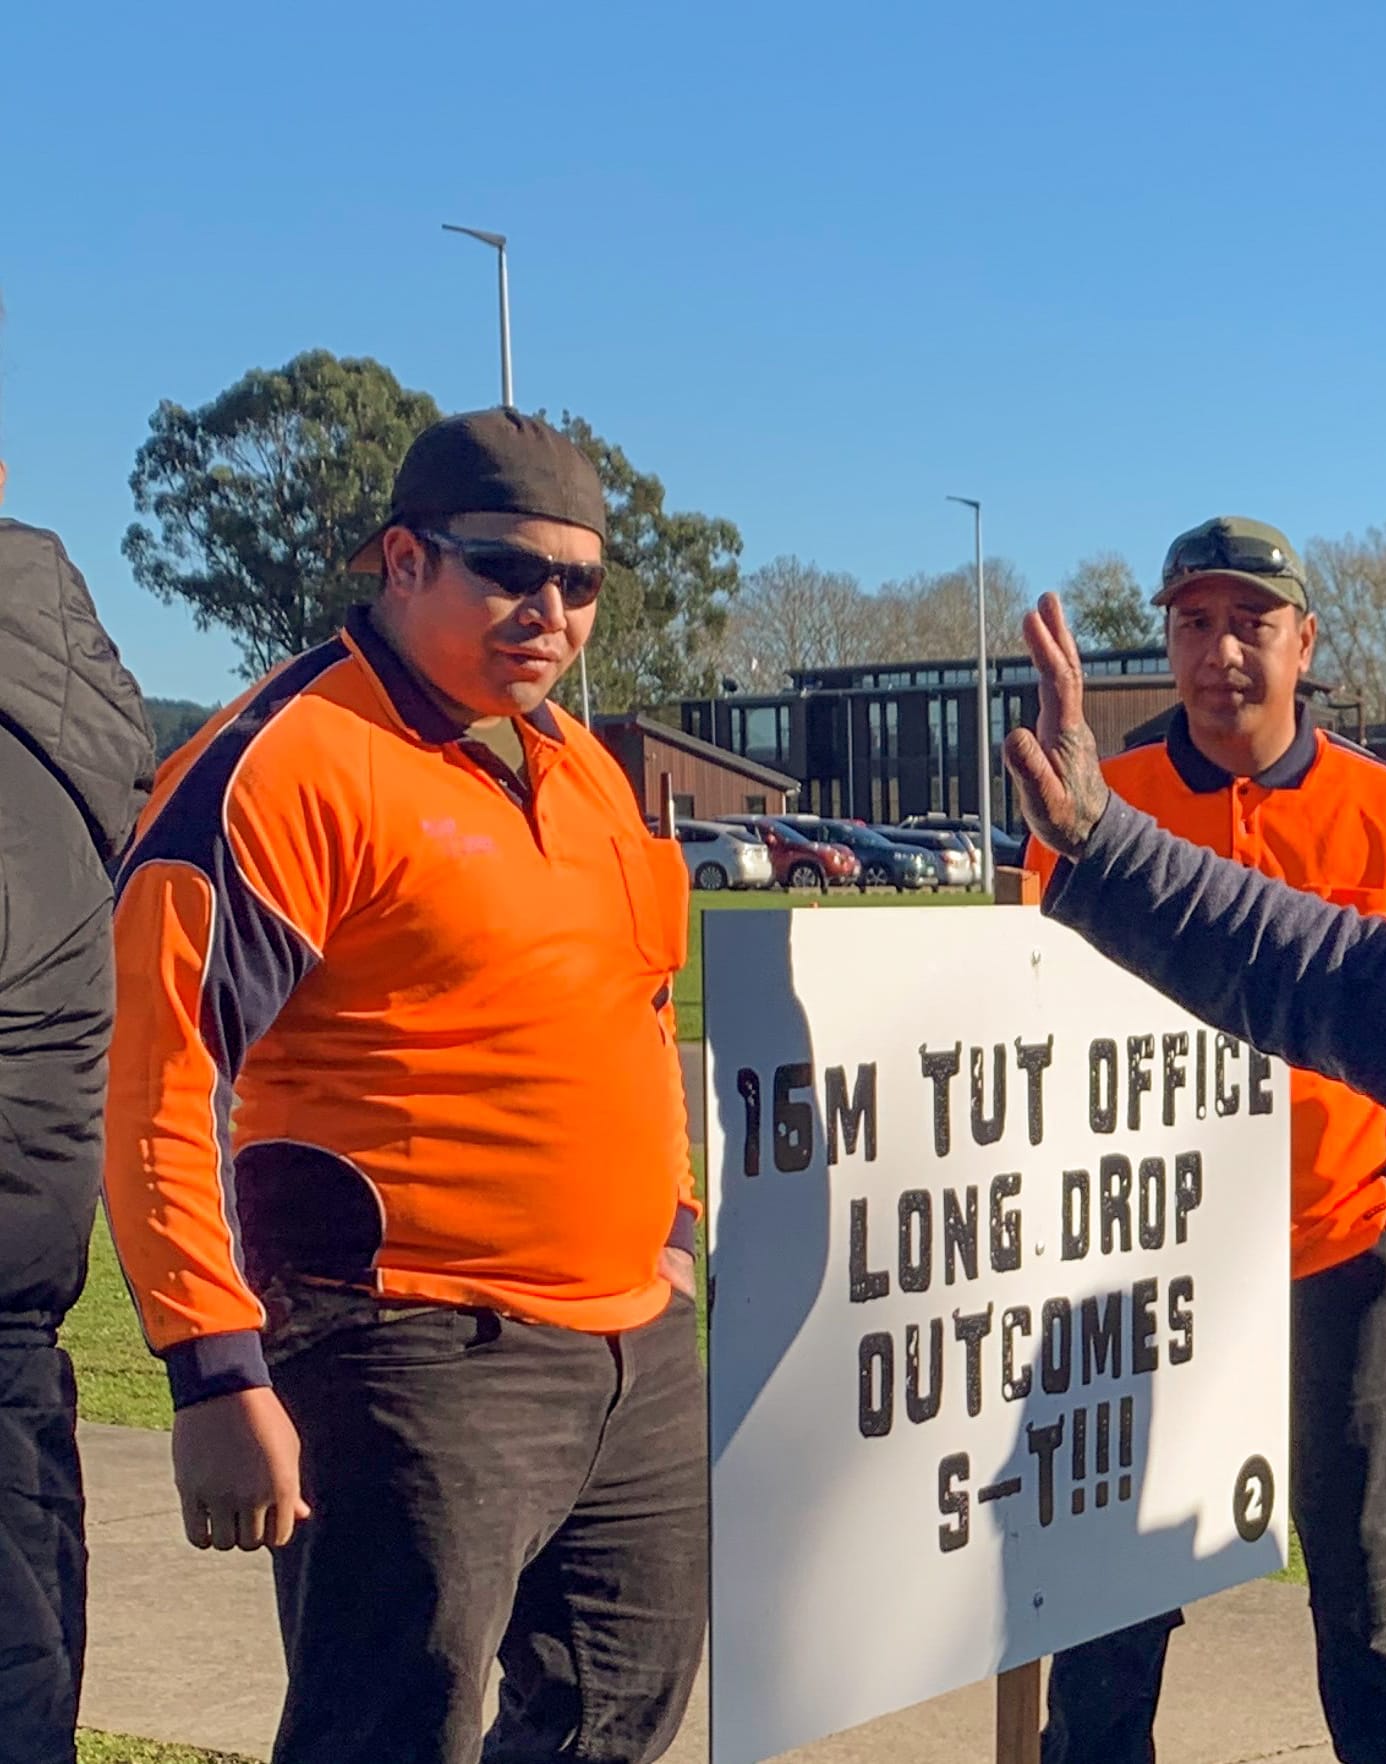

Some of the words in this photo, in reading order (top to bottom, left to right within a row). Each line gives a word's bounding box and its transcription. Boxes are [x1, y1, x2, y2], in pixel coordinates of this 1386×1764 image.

[737, 1062, 877, 1178] 16M
[919, 1034, 1054, 1157] TUT
[1088, 1029, 1274, 1135] OFFICE
[849, 1172, 1022, 1304] LONG
[1060, 1150, 1203, 1261] DROP
[858, 1275, 1194, 1439] OUTCOMES
